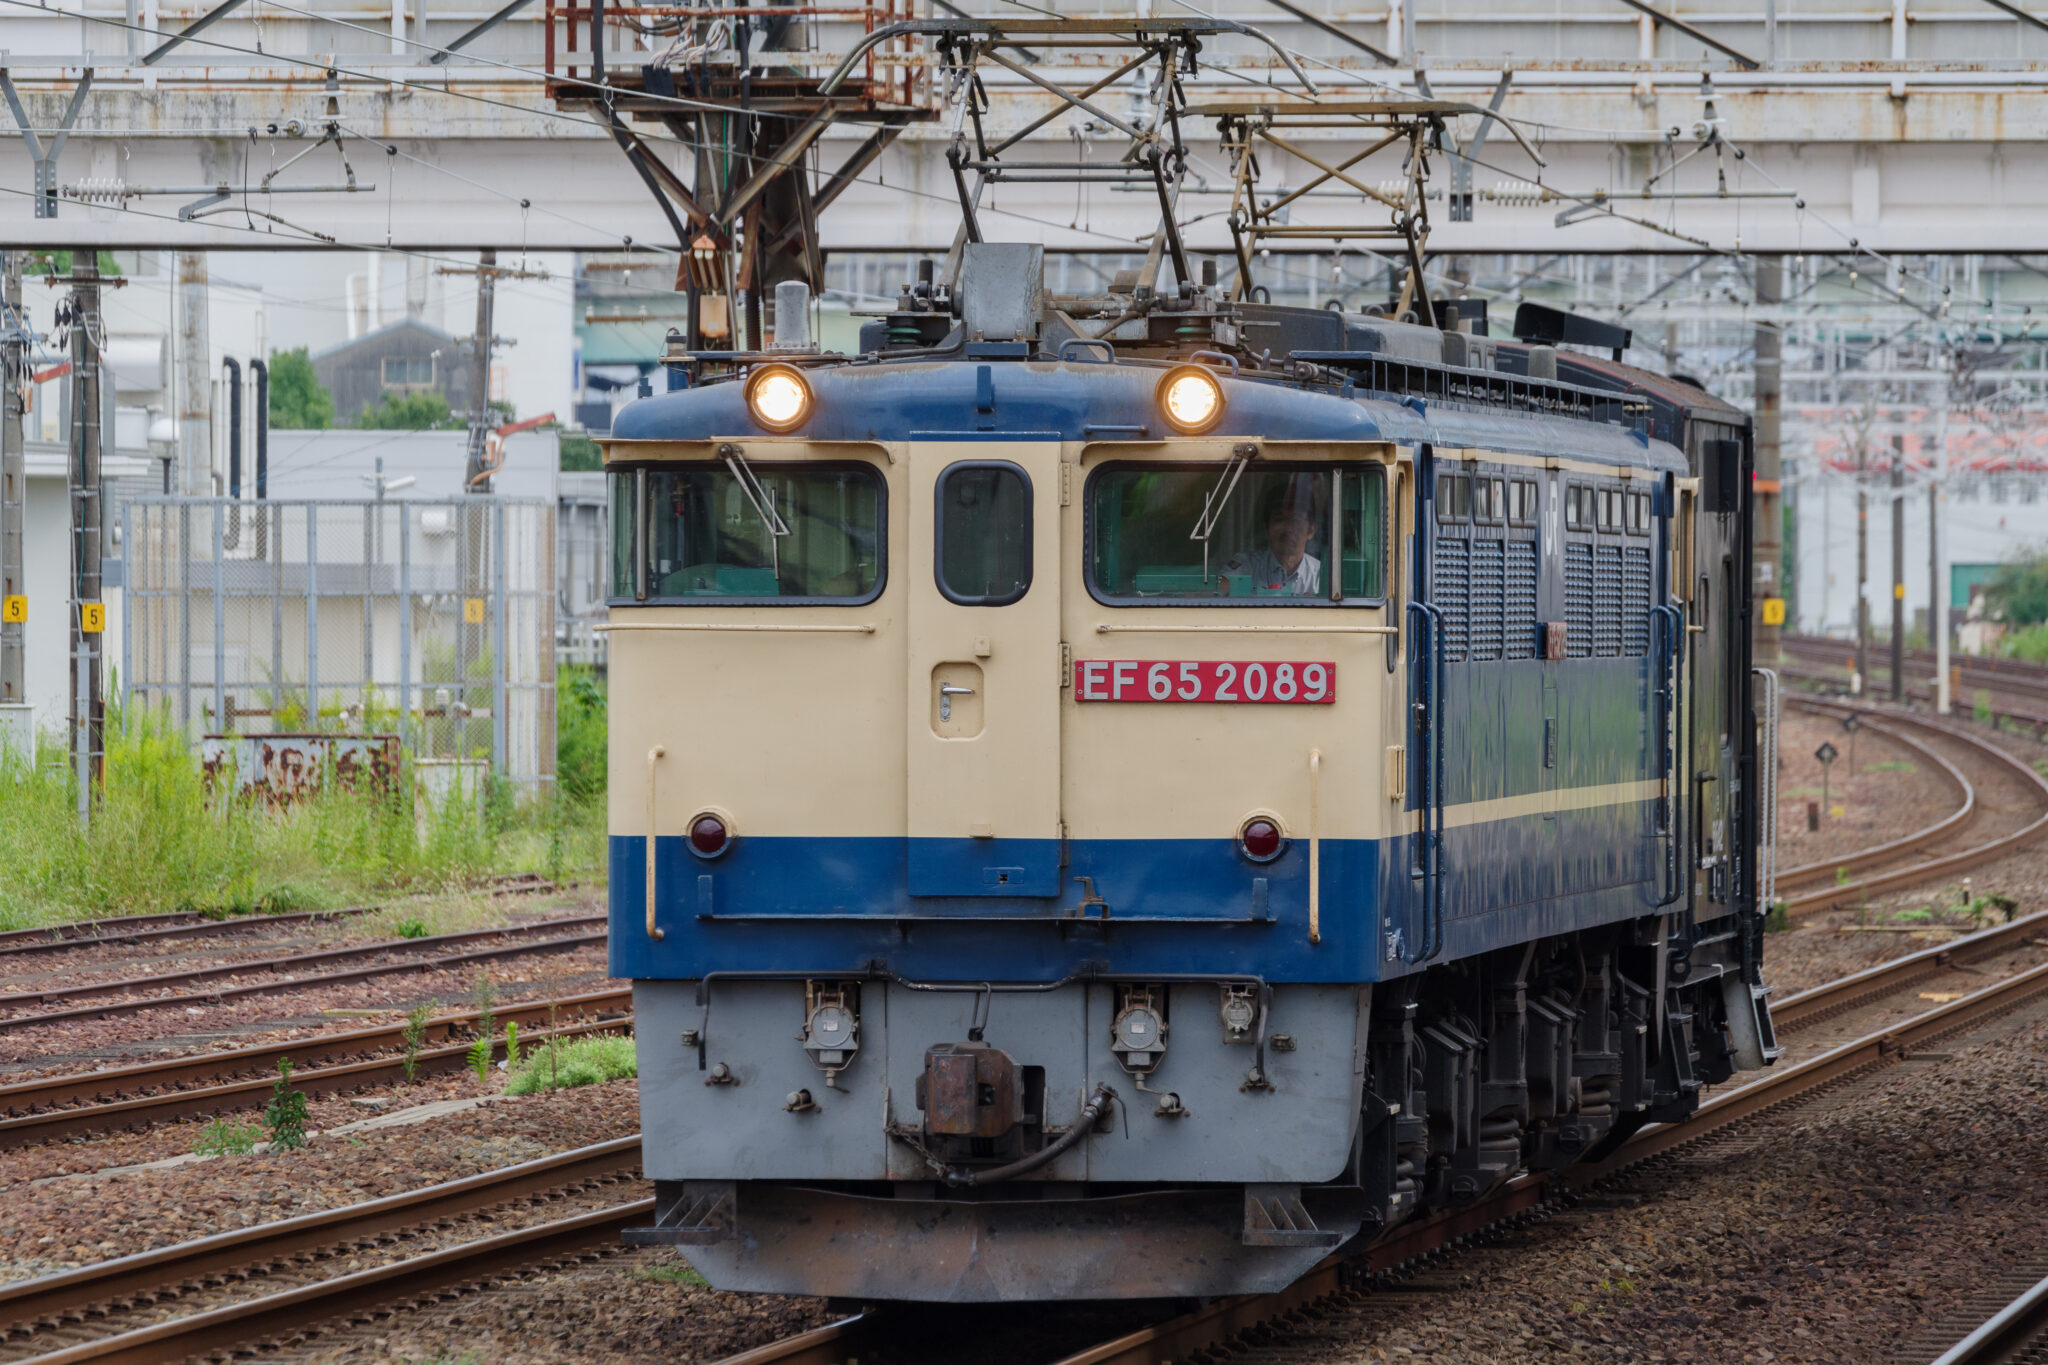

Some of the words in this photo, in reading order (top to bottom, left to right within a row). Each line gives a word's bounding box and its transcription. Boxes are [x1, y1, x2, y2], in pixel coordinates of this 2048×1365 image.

[11, 601, 20, 616] 5
[90, 609, 98, 625] 5
[1214, 662, 1328, 702] 2089
